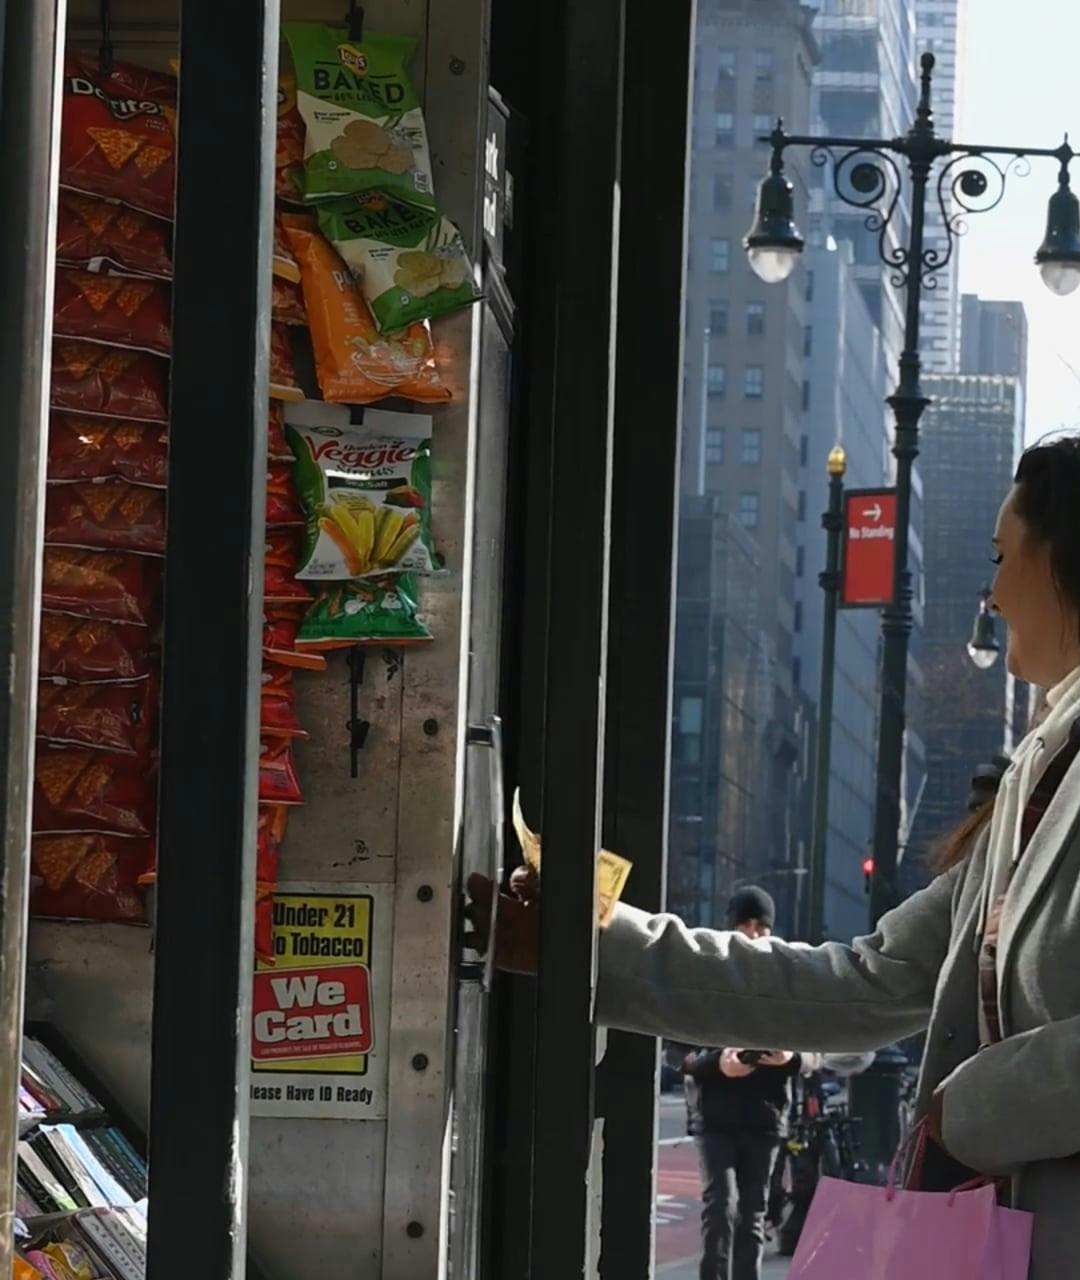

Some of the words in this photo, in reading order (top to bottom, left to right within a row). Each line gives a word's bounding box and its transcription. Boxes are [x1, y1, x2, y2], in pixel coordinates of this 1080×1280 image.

[71, 78, 162, 114] Dorito
[313, 68, 405, 104] BAKED
[344, 202, 417, 234] BAKE
[305, 435, 418, 469] Veggie
[849, 527, 860, 539] No
[861, 525, 894, 541] Standing
[273, 902, 328, 928] Under
[334, 903, 355, 928] 21
[273, 932, 286, 956] o
[291, 932, 363, 957] Tobacco
[270, 975, 346, 1009] We
[254, 1004, 363, 1043] Card
[250, 1084, 282, 1100] lease
[286, 1084, 315, 1101] Have
[320, 1086, 332, 1101] ID
[336, 1086, 373, 1105] Ready
